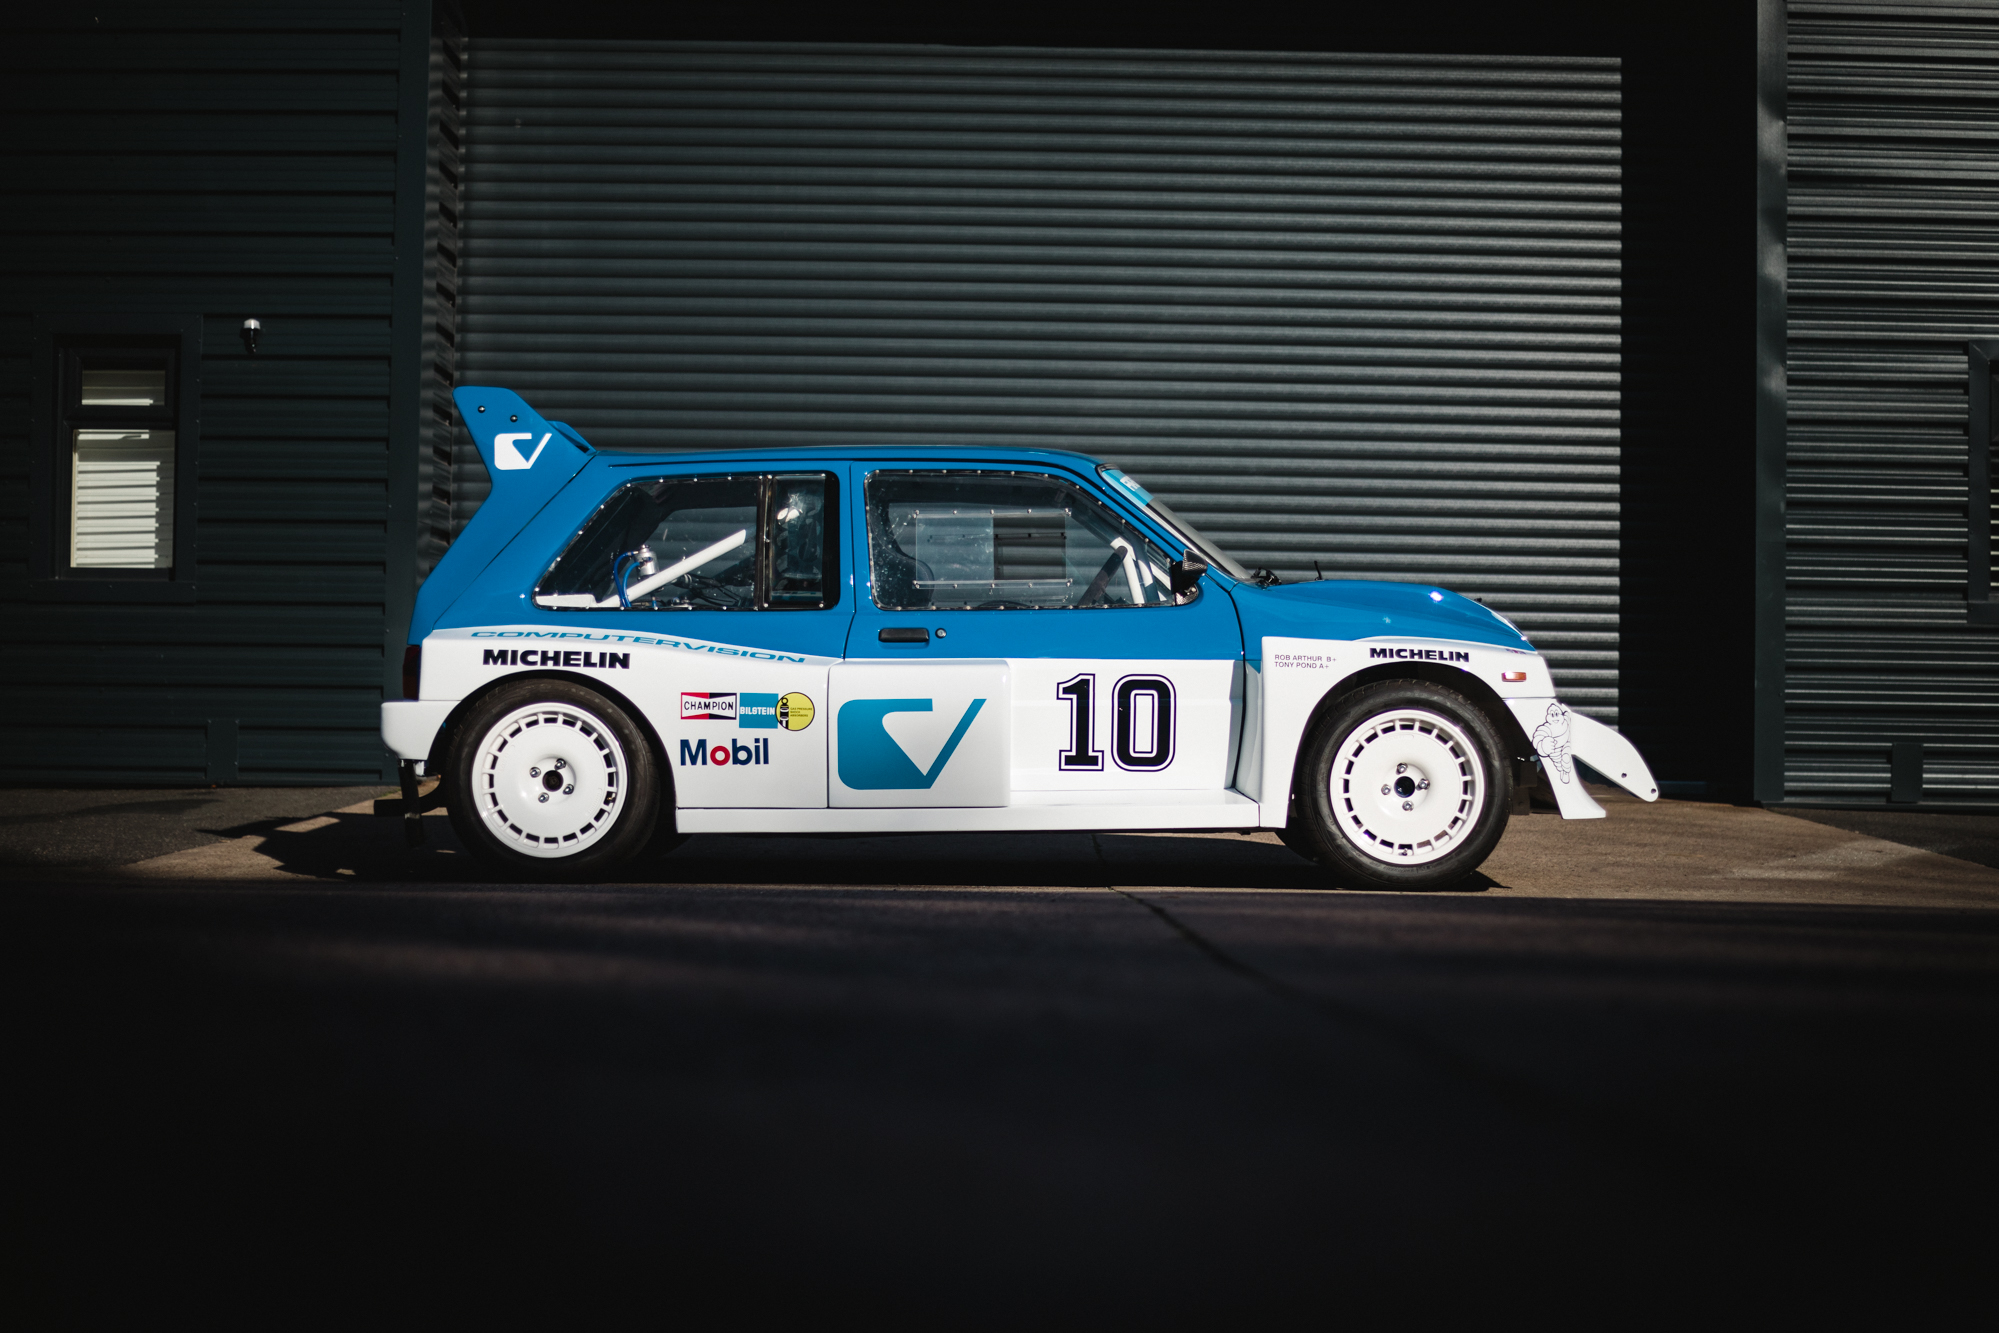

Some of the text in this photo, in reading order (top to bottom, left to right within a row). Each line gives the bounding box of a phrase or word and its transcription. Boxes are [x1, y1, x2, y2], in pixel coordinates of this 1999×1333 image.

[471, 631, 806, 663] COMPUTERVISION
[1369, 647, 1470, 663] MICHELIN
[483, 649, 631, 669] MICHELIN
[683, 701, 734, 711] CHAMPION
[739, 706, 775, 716] BILSTEIN
[1056, 673, 1177, 773] 10
[680, 737, 770, 766] Mobil
